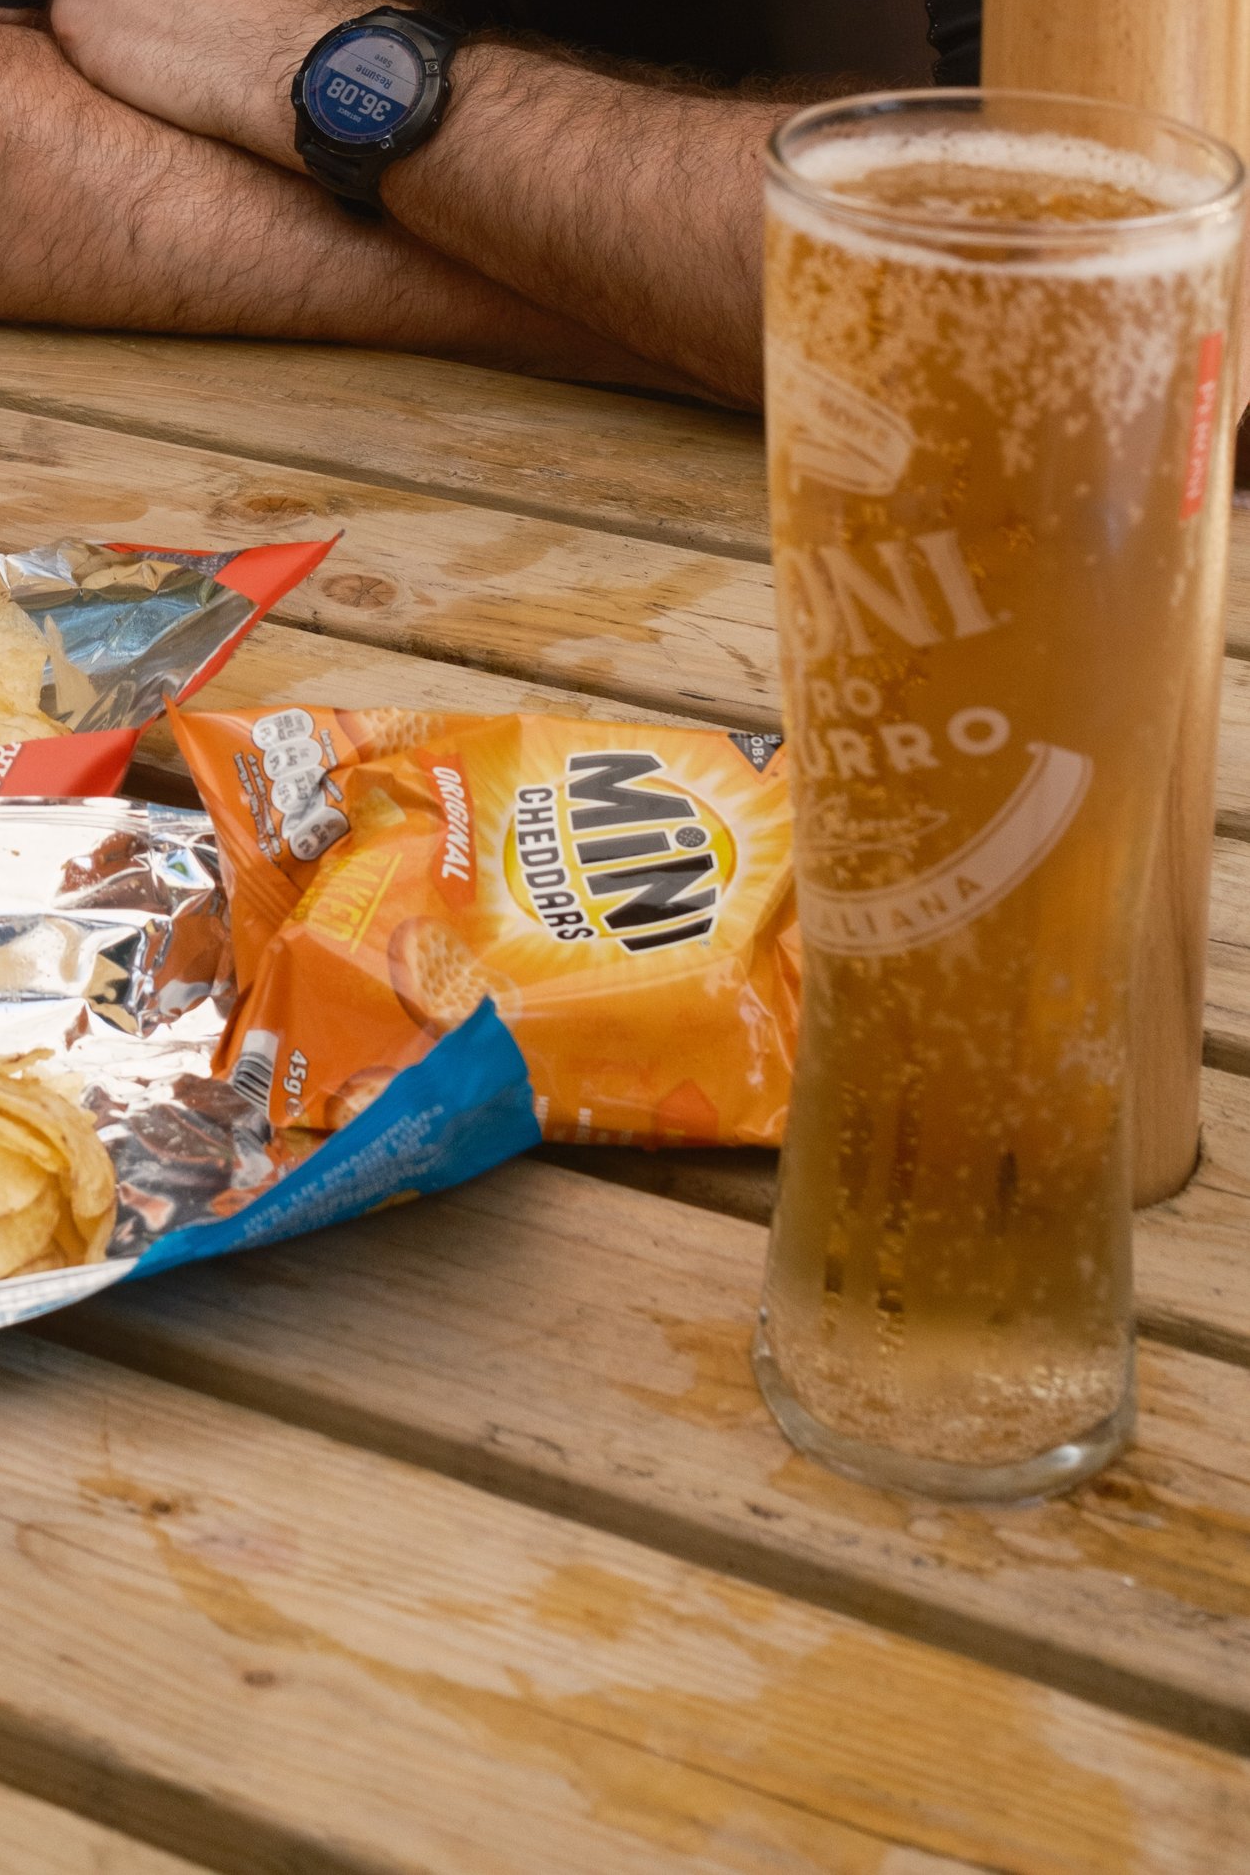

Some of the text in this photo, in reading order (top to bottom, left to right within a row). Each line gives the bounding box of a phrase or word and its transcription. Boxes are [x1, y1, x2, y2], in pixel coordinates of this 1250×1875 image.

[355, 63, 393, 91] Resume
[374, 53, 393, 69] Save
[326, 77, 392, 122] 36.08
[432, 766, 470, 882] ORIGINAL
[517, 787, 595, 941] CHEDDARS
[283, 1048, 308, 1096] 45g
